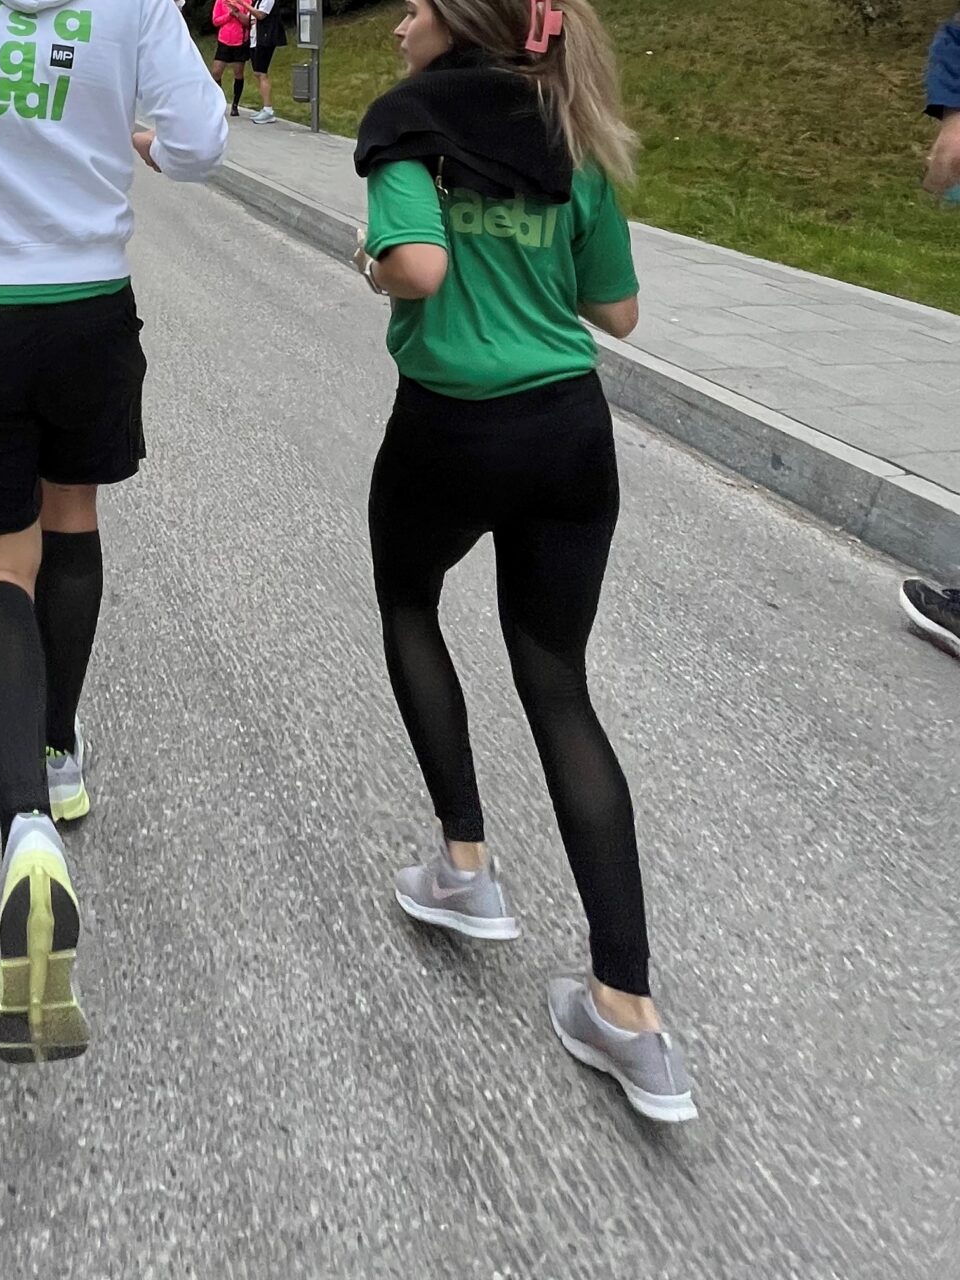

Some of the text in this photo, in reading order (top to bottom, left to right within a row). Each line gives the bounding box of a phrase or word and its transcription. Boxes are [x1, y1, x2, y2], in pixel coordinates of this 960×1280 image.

[53, 9, 93, 44] a
[52, 50, 73, 61] MP
[449, 193, 558, 248] deal
